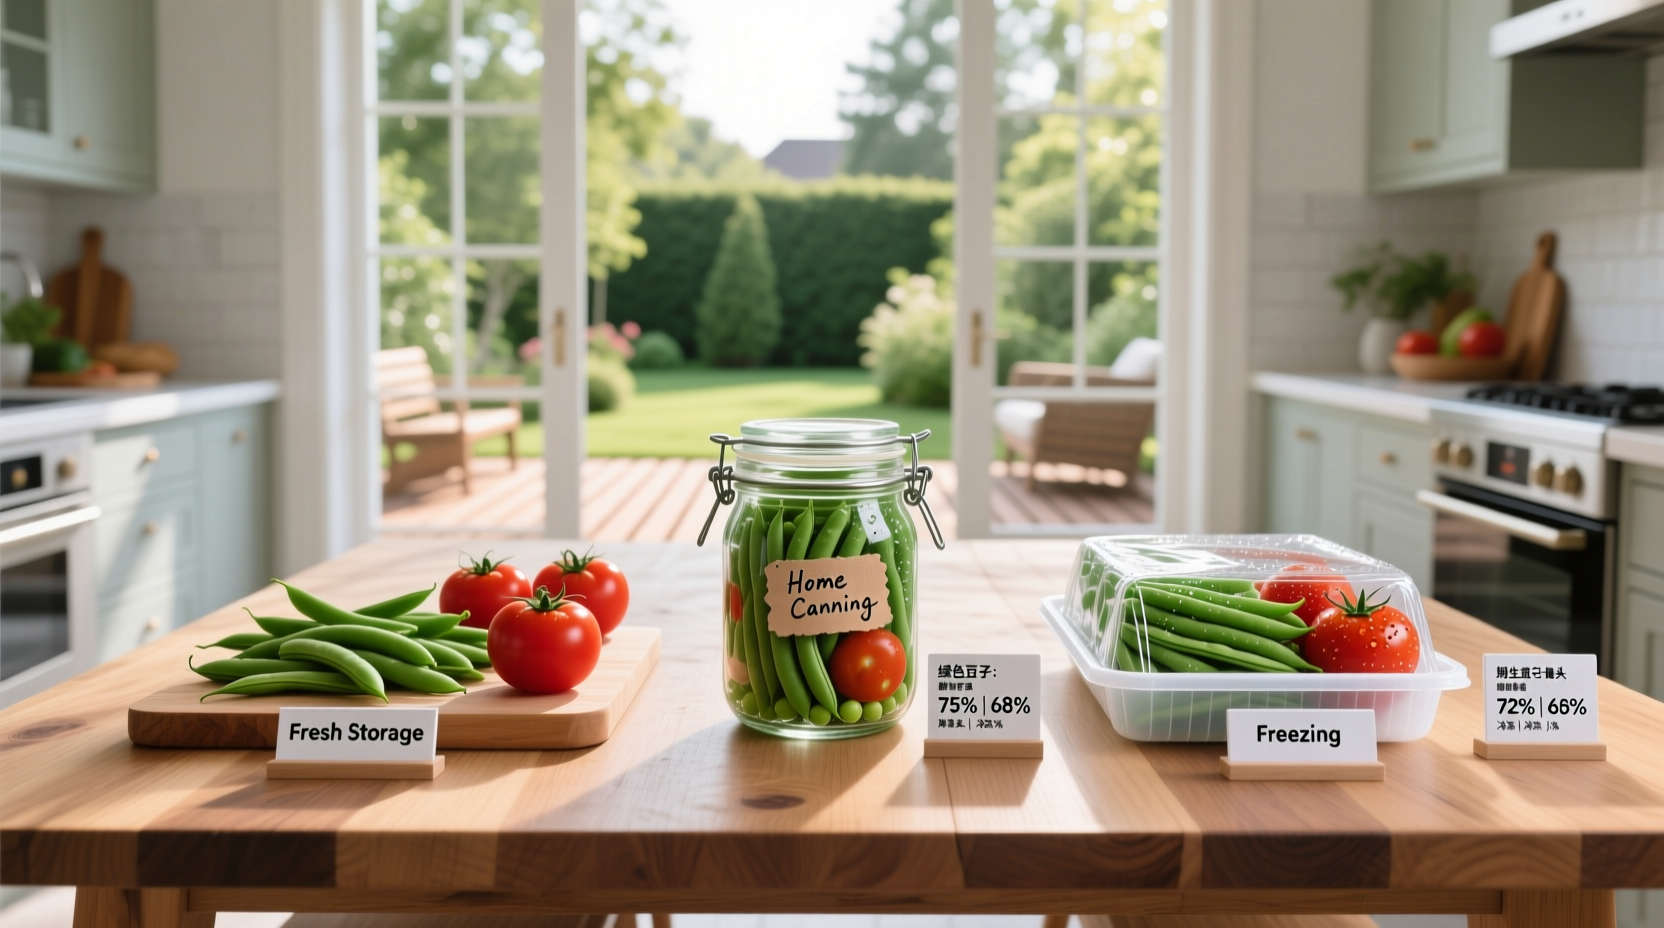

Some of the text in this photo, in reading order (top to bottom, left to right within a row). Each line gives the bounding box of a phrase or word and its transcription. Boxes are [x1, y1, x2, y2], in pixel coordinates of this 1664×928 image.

[788, 569, 847, 594] Home
[790, 594, 878, 622] Canning
[938, 696, 1031, 714] 75% 68%
[1496, 697, 1536, 715] 72%
[289, 722, 424, 746] Fresh Storage
[1256, 723, 1341, 748] Freezing
